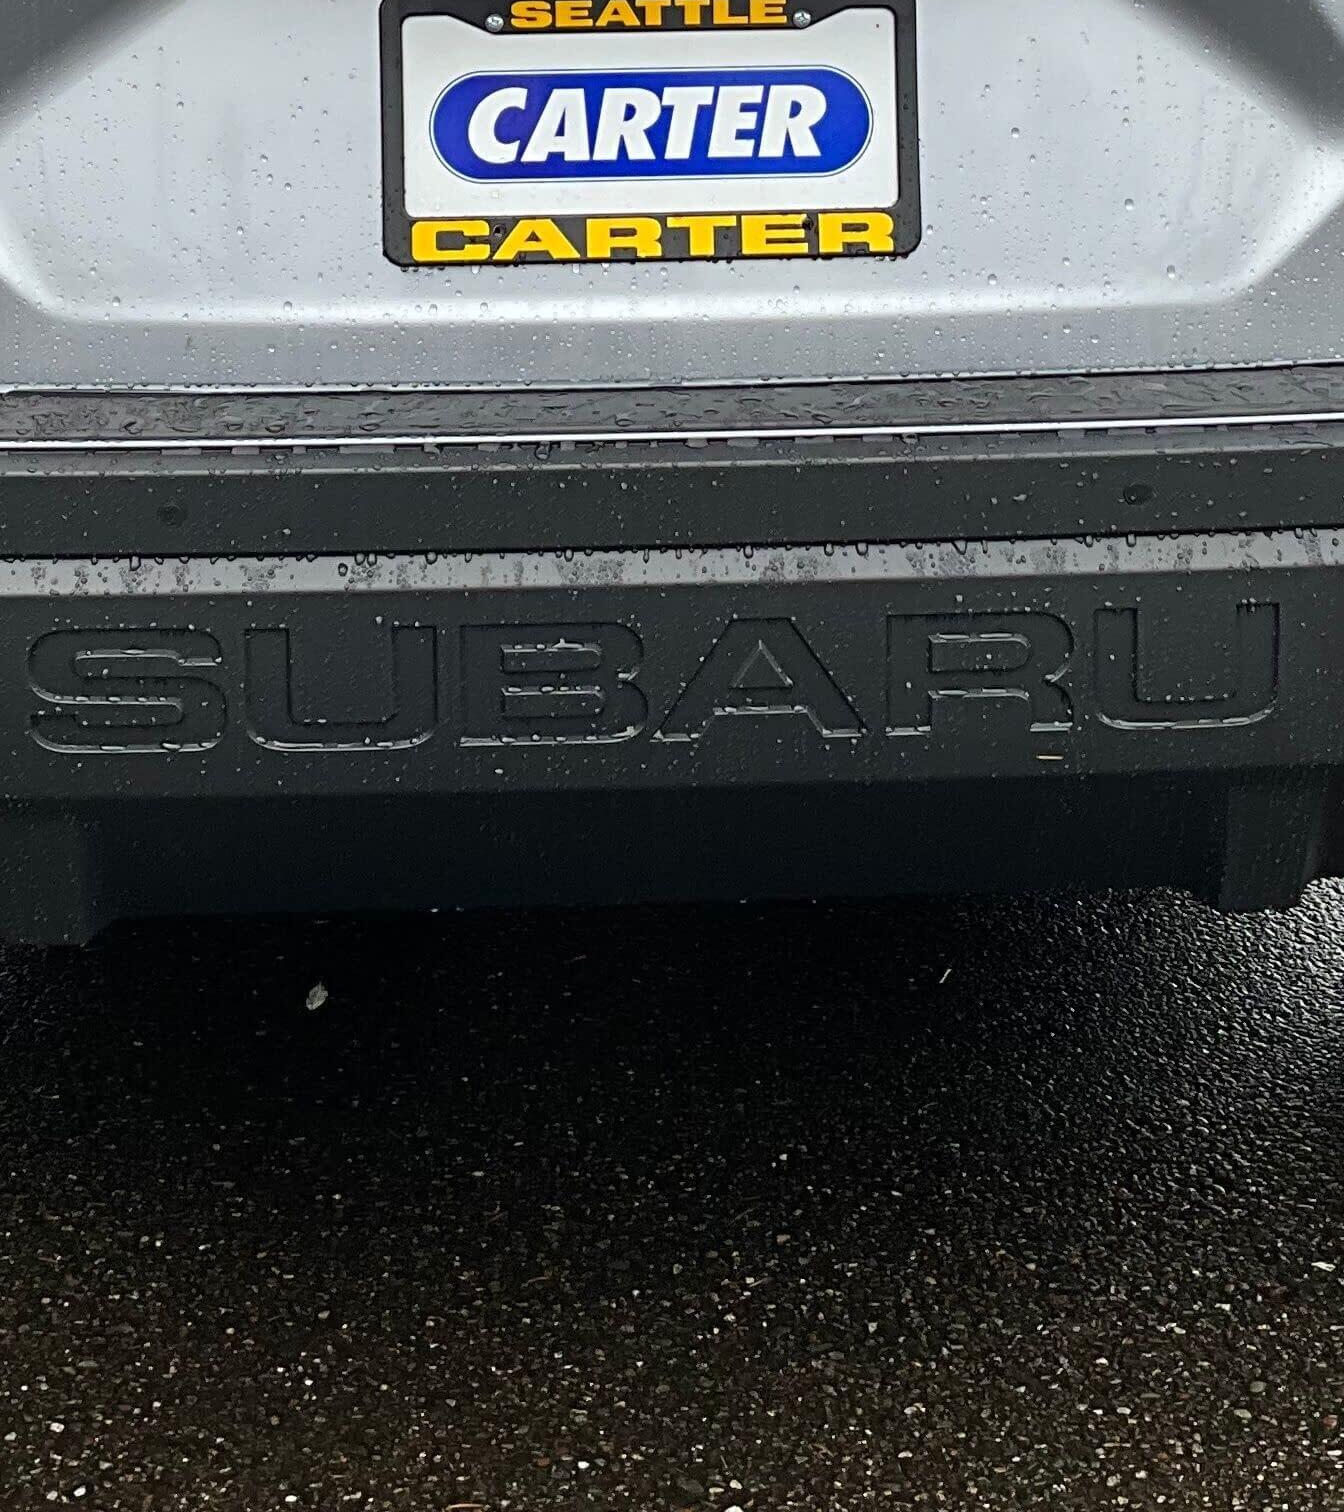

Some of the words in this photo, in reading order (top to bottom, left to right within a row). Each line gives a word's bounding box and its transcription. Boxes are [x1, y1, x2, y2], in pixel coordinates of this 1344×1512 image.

[467, 84, 827, 164] CARTER
[410, 212, 895, 262] CARTER
[27, 603, 1281, 753] SUBARU
